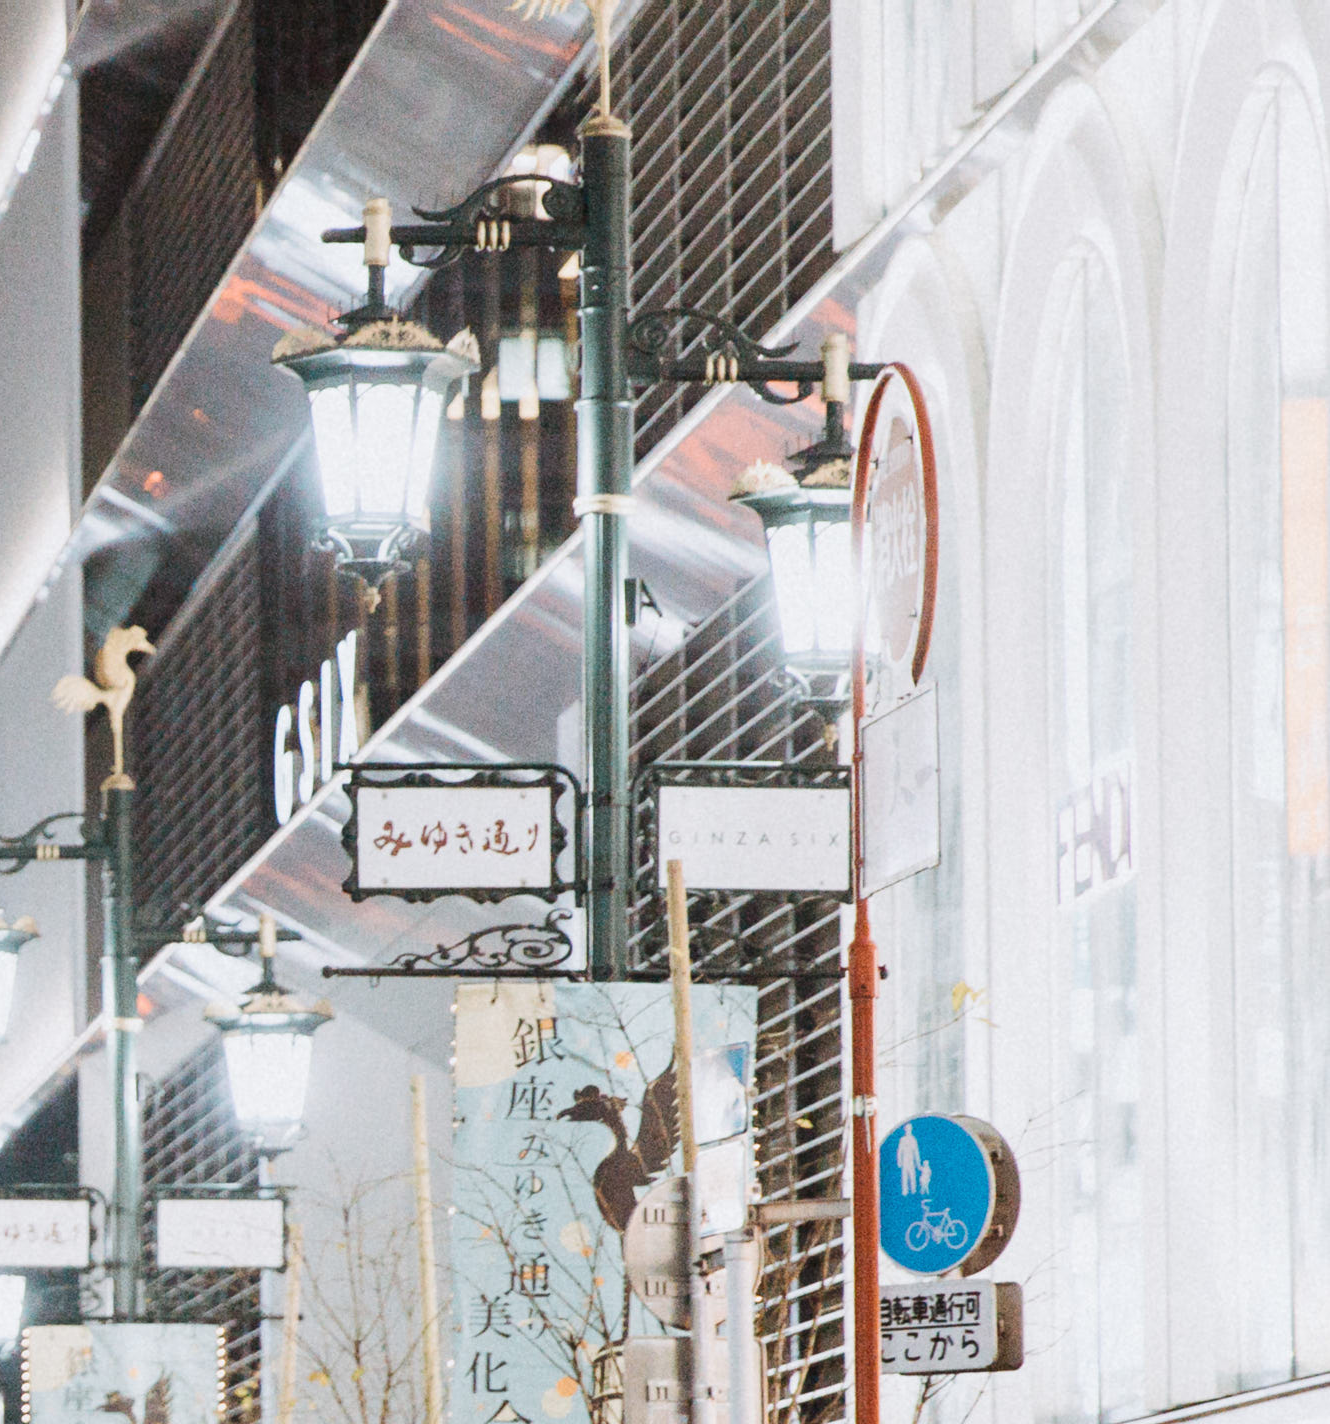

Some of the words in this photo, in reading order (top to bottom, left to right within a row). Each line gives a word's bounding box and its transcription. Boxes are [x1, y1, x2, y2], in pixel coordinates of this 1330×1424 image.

[371, 818, 541, 858] みゆき通り
[669, 829, 771, 846] GINZA
[789, 829, 841, 846] SIX
[506, 1017, 565, 1341] 銀座みゆき通り
[881, 1330, 981, 1364] ここから
